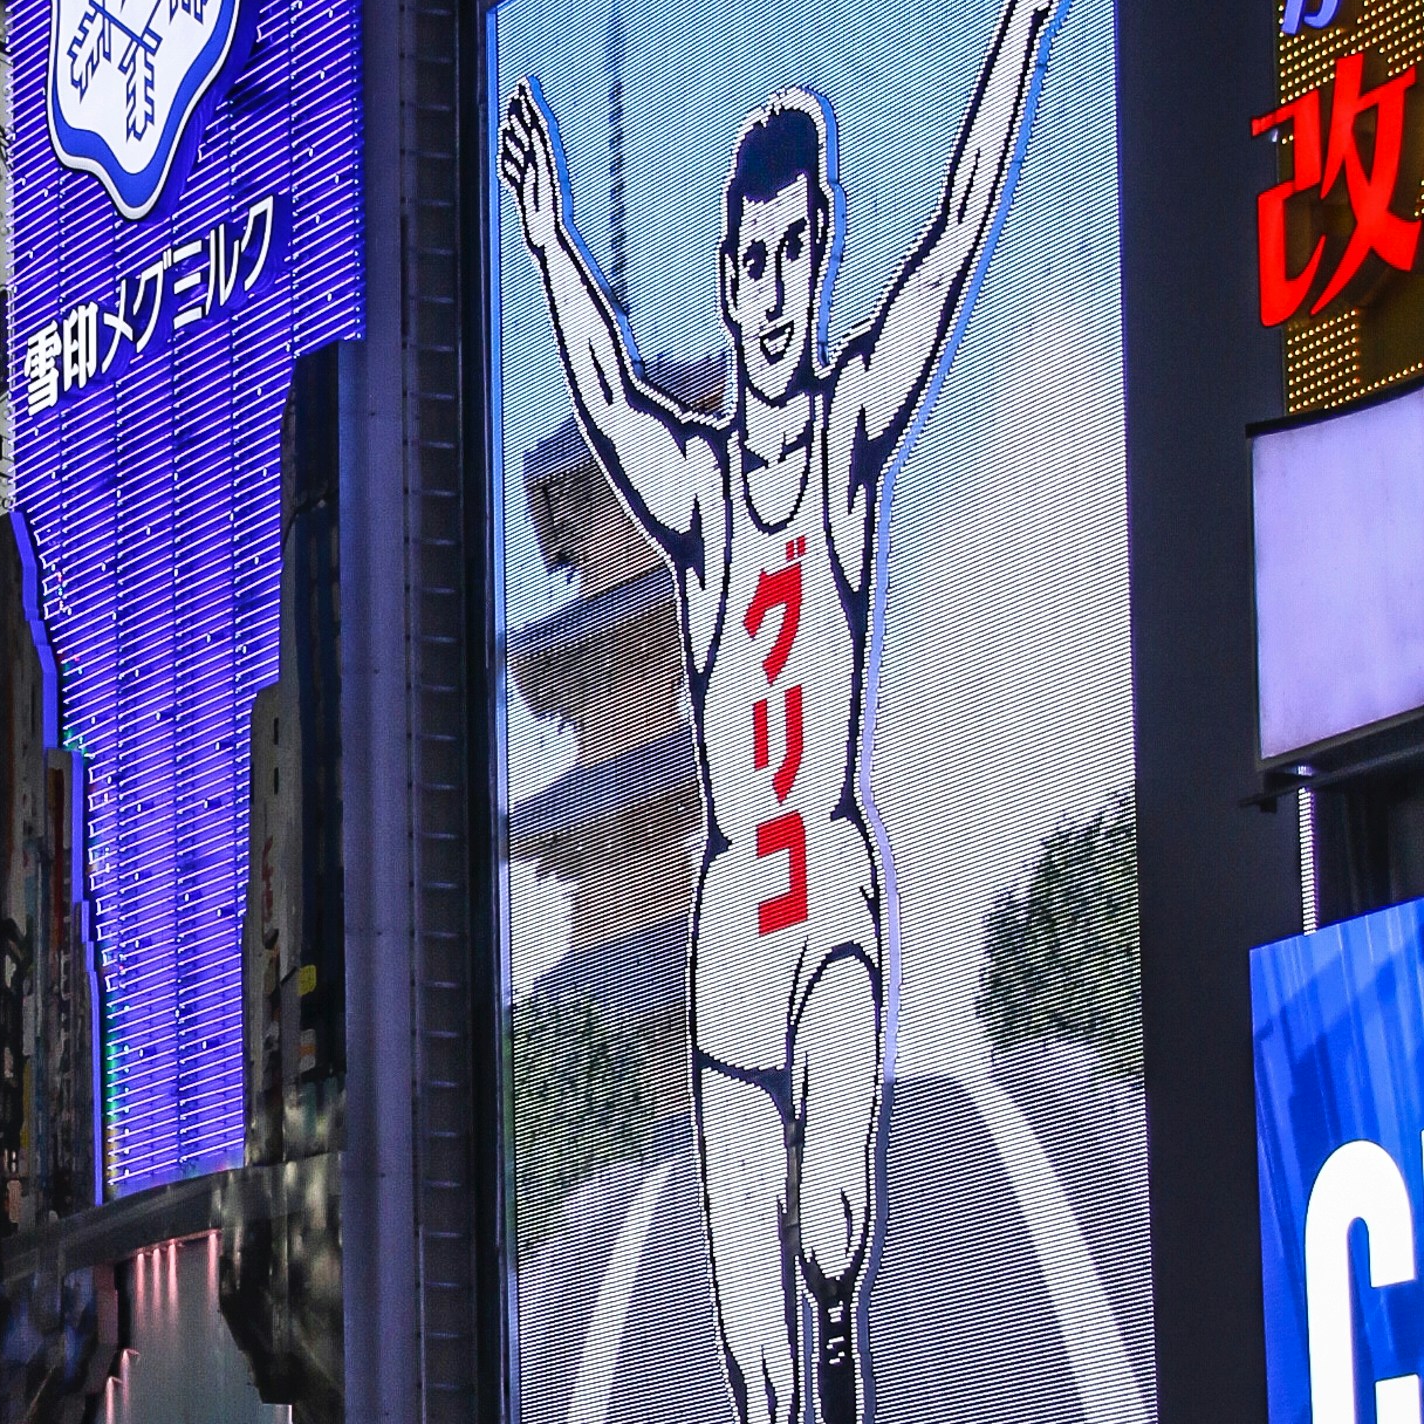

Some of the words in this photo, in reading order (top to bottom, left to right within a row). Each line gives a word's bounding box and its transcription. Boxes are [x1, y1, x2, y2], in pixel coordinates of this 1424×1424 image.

[23, 193, 276, 419] 雪印メグミルク
[1251, 52, 1423, 329] 改
[743, 535, 809, 938] グリコ
